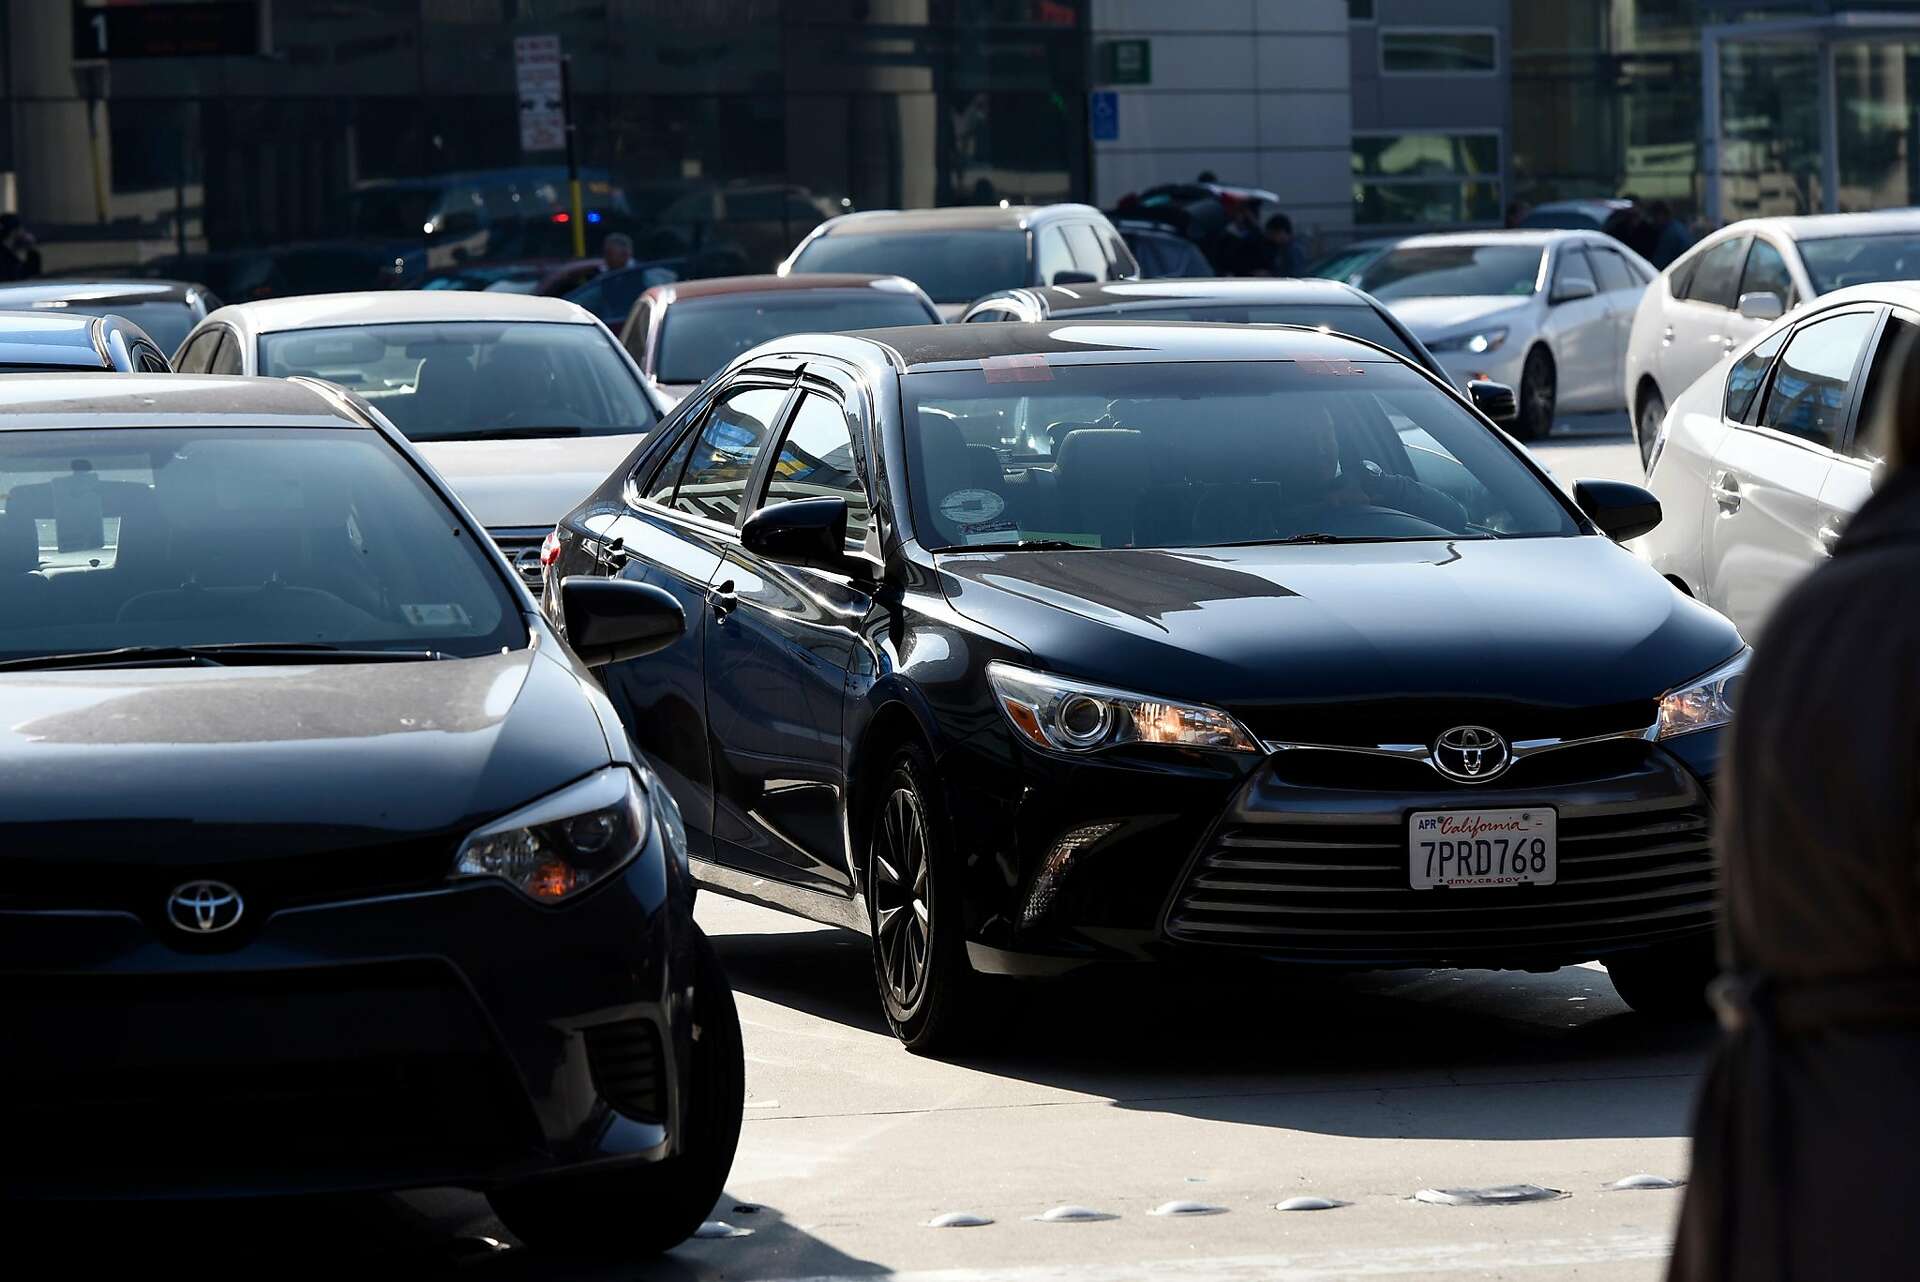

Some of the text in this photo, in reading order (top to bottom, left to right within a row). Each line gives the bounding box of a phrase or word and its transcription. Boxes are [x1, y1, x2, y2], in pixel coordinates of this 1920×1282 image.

[89, 13, 109, 52] 1
[1418, 816, 1529, 838] APR California
[1420, 838, 1546, 878] 7PRD768
[1446, 876, 1521, 885] dmv.ca.gov
